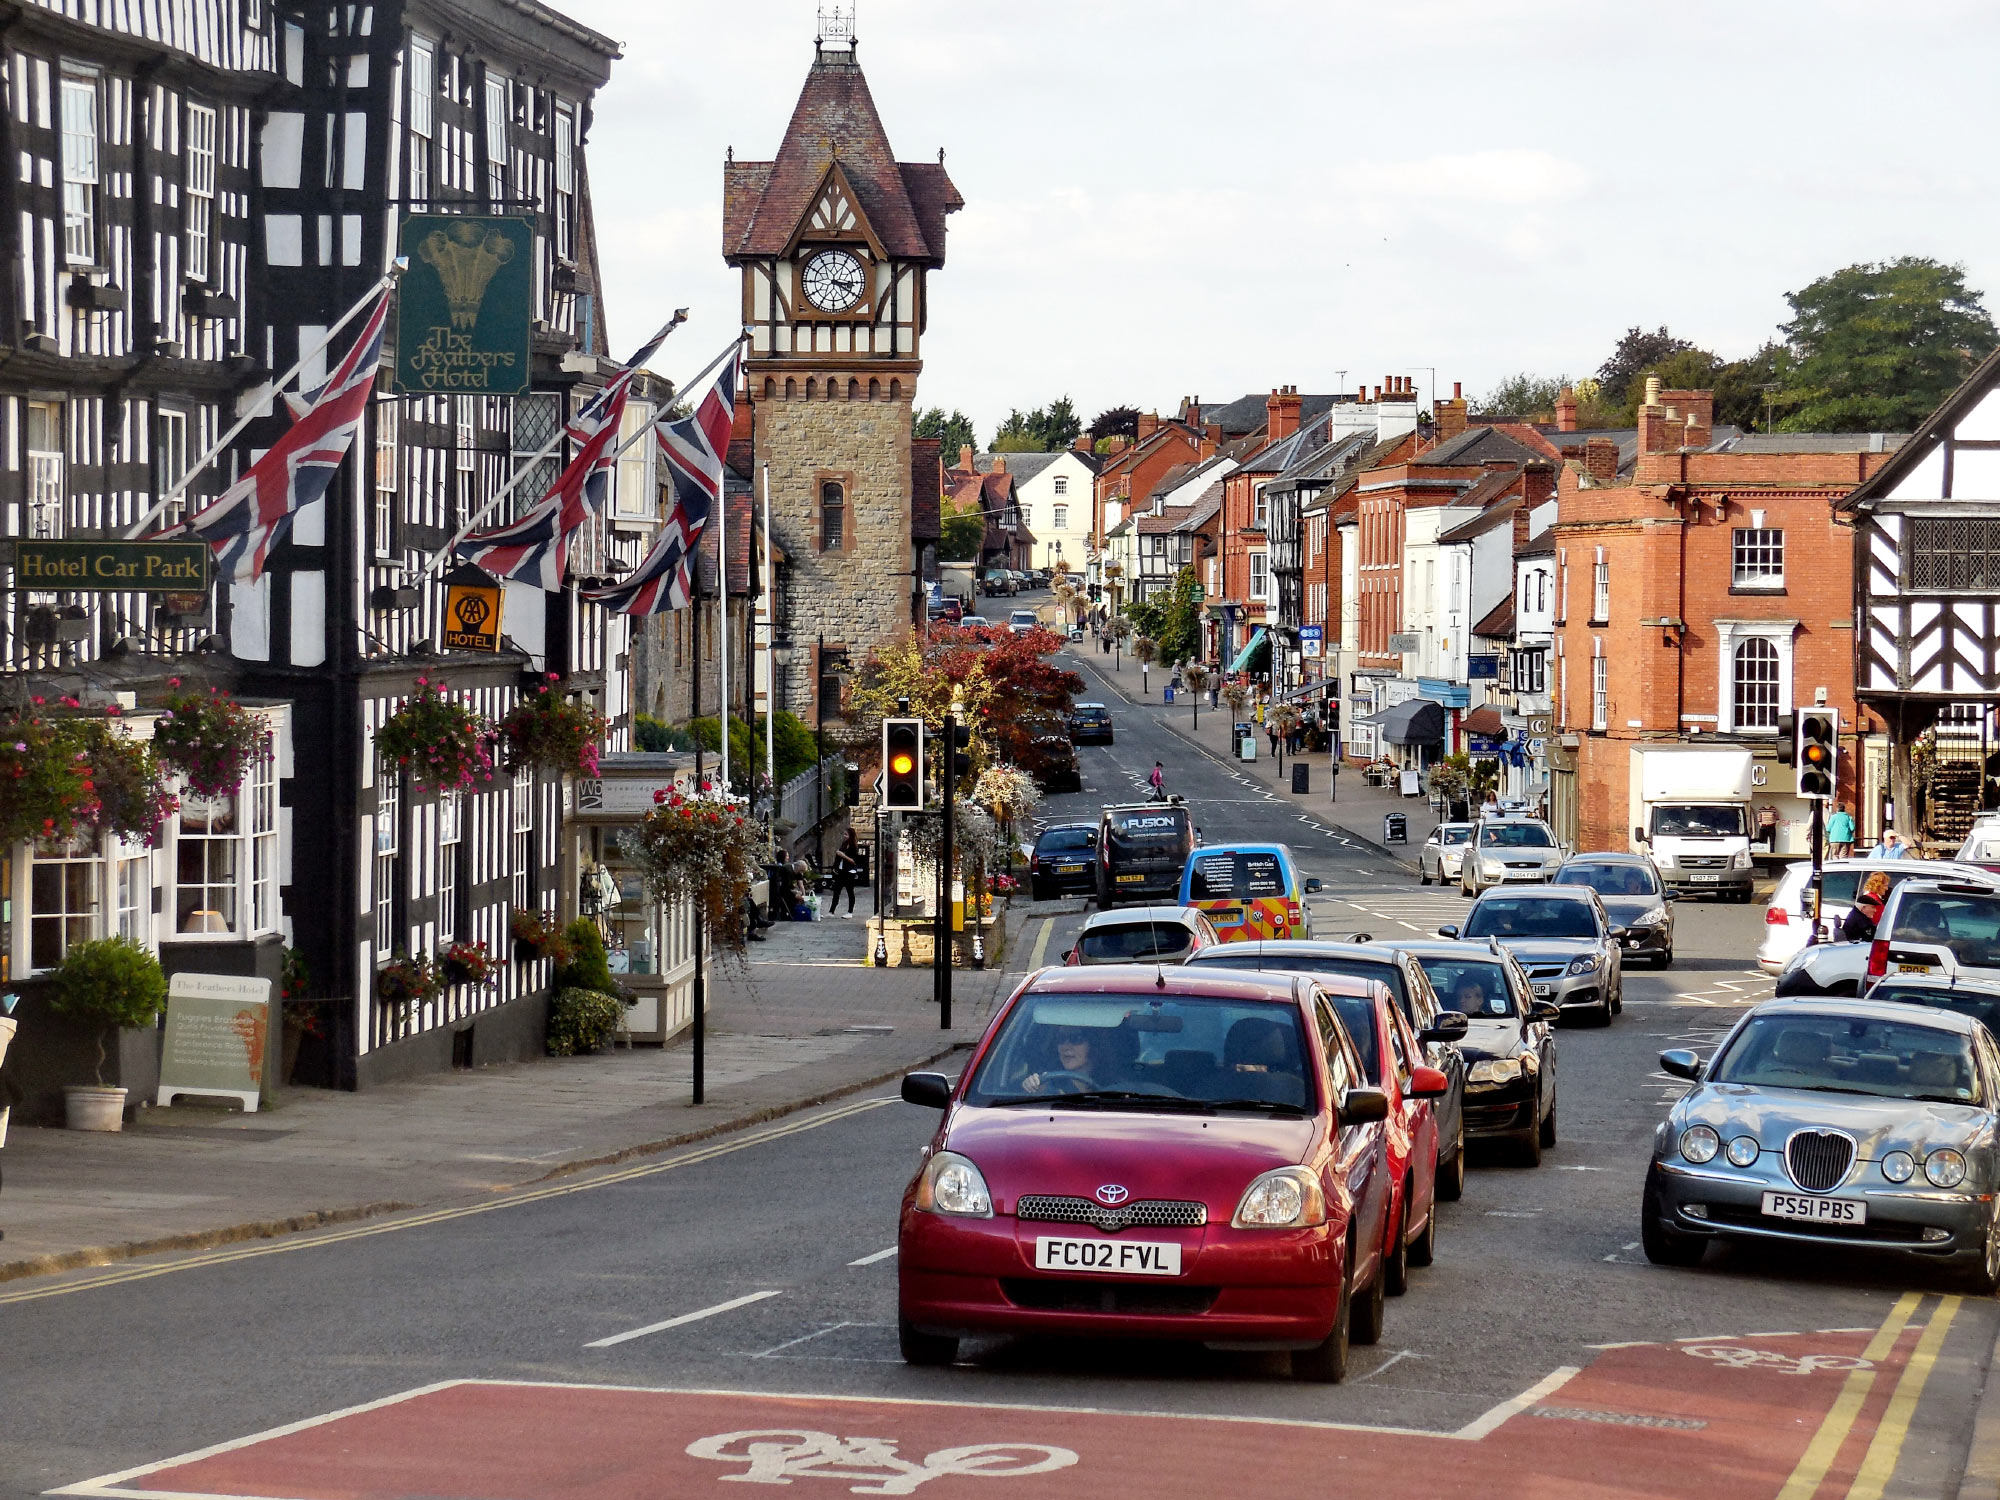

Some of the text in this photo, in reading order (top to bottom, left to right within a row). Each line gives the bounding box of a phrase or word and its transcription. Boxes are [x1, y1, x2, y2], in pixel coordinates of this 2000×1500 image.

[426, 326, 472, 351] The
[410, 345, 515, 370] Feathers
[421, 367, 489, 388] Hotel
[22, 554, 200, 578] Hotel Car Park
[449, 633, 491, 648] HOTEL
[1127, 817, 1175, 829] FUSION
[1220, 914, 1234, 922] NKR
[176, 980, 264, 994] The Feathers Hotel
[1531, 985, 1546, 994] UR
[214, 1015, 255, 1025] Brasserie
[229, 1025, 255, 1035] Dining
[224, 1042, 252, 1051] Rooms
[1773, 1195, 1855, 1220] PS51 PBS
[1047, 1241, 1169, 1270] FC02 FVL
